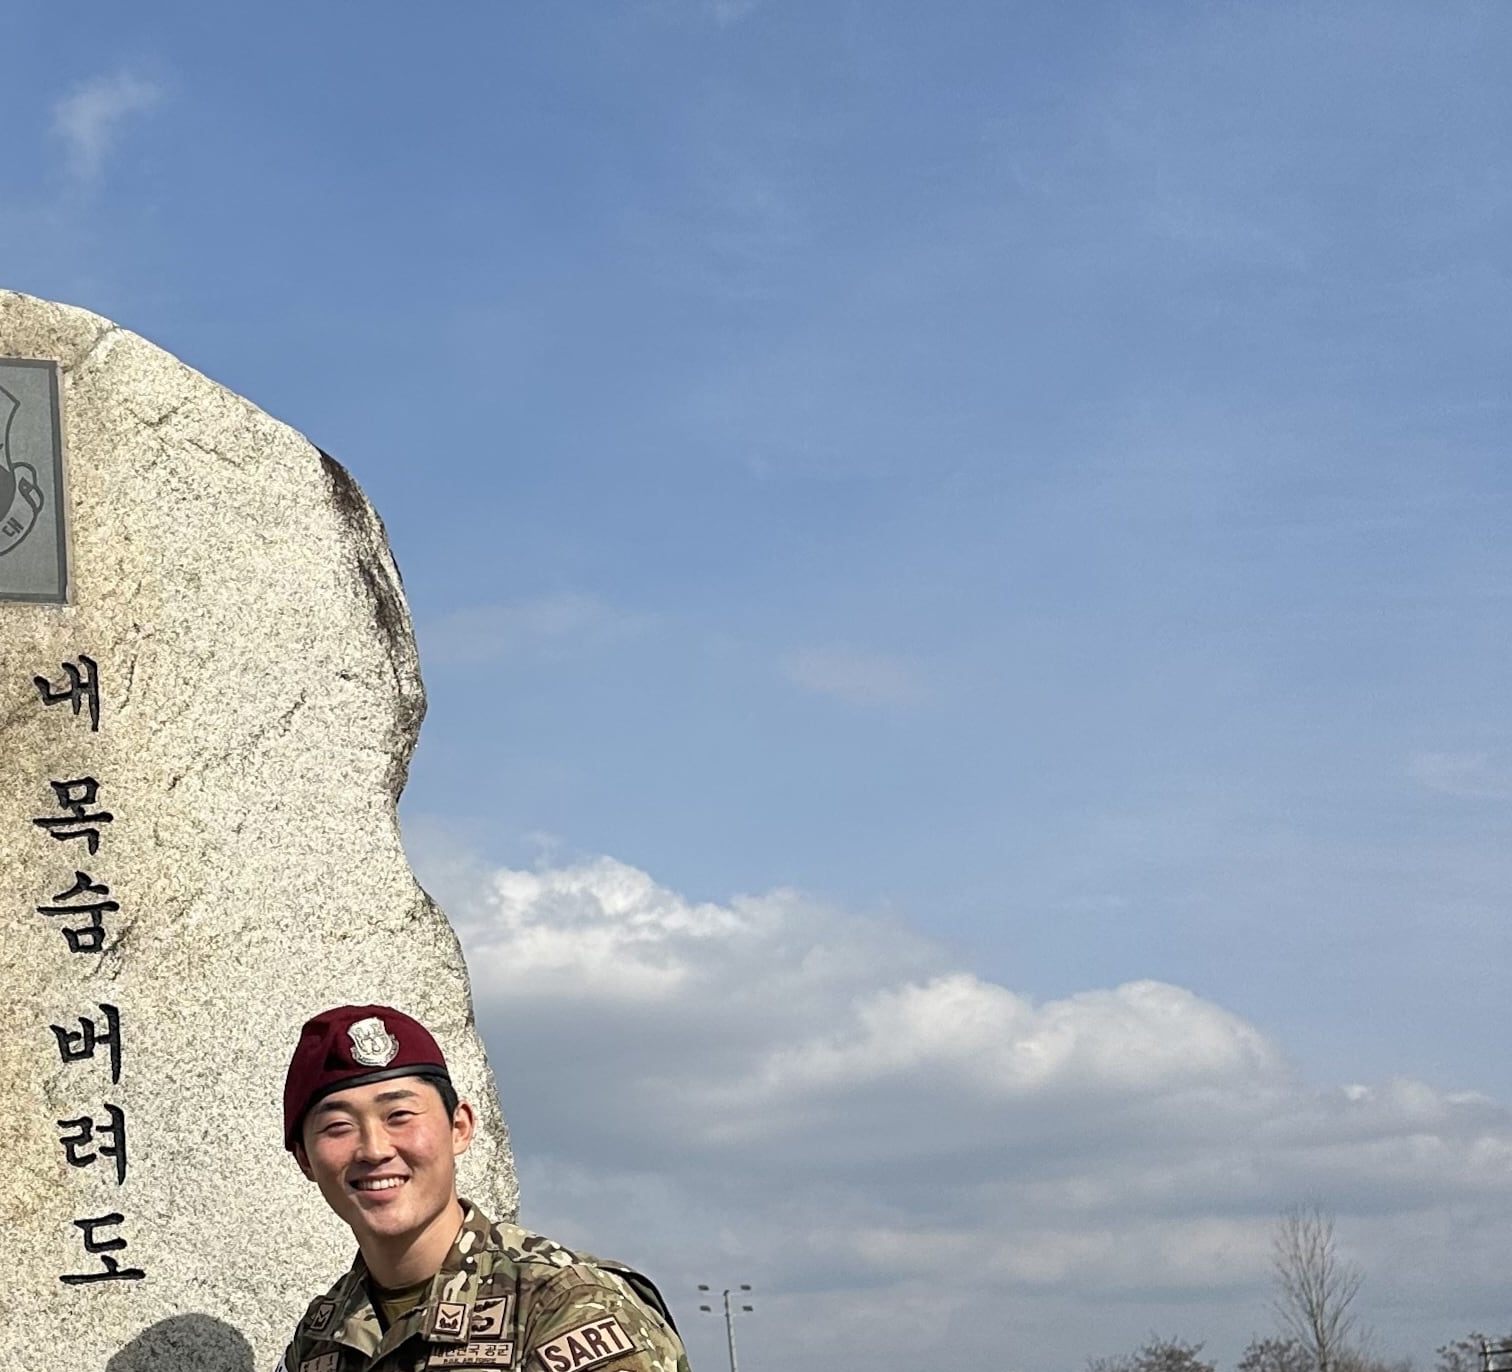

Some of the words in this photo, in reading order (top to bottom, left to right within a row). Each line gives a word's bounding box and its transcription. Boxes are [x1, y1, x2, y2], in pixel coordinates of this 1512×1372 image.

[33, 654, 100, 732] 내
[32, 776, 120, 954] 목숨
[49, 1003, 146, 1286] 버려도
